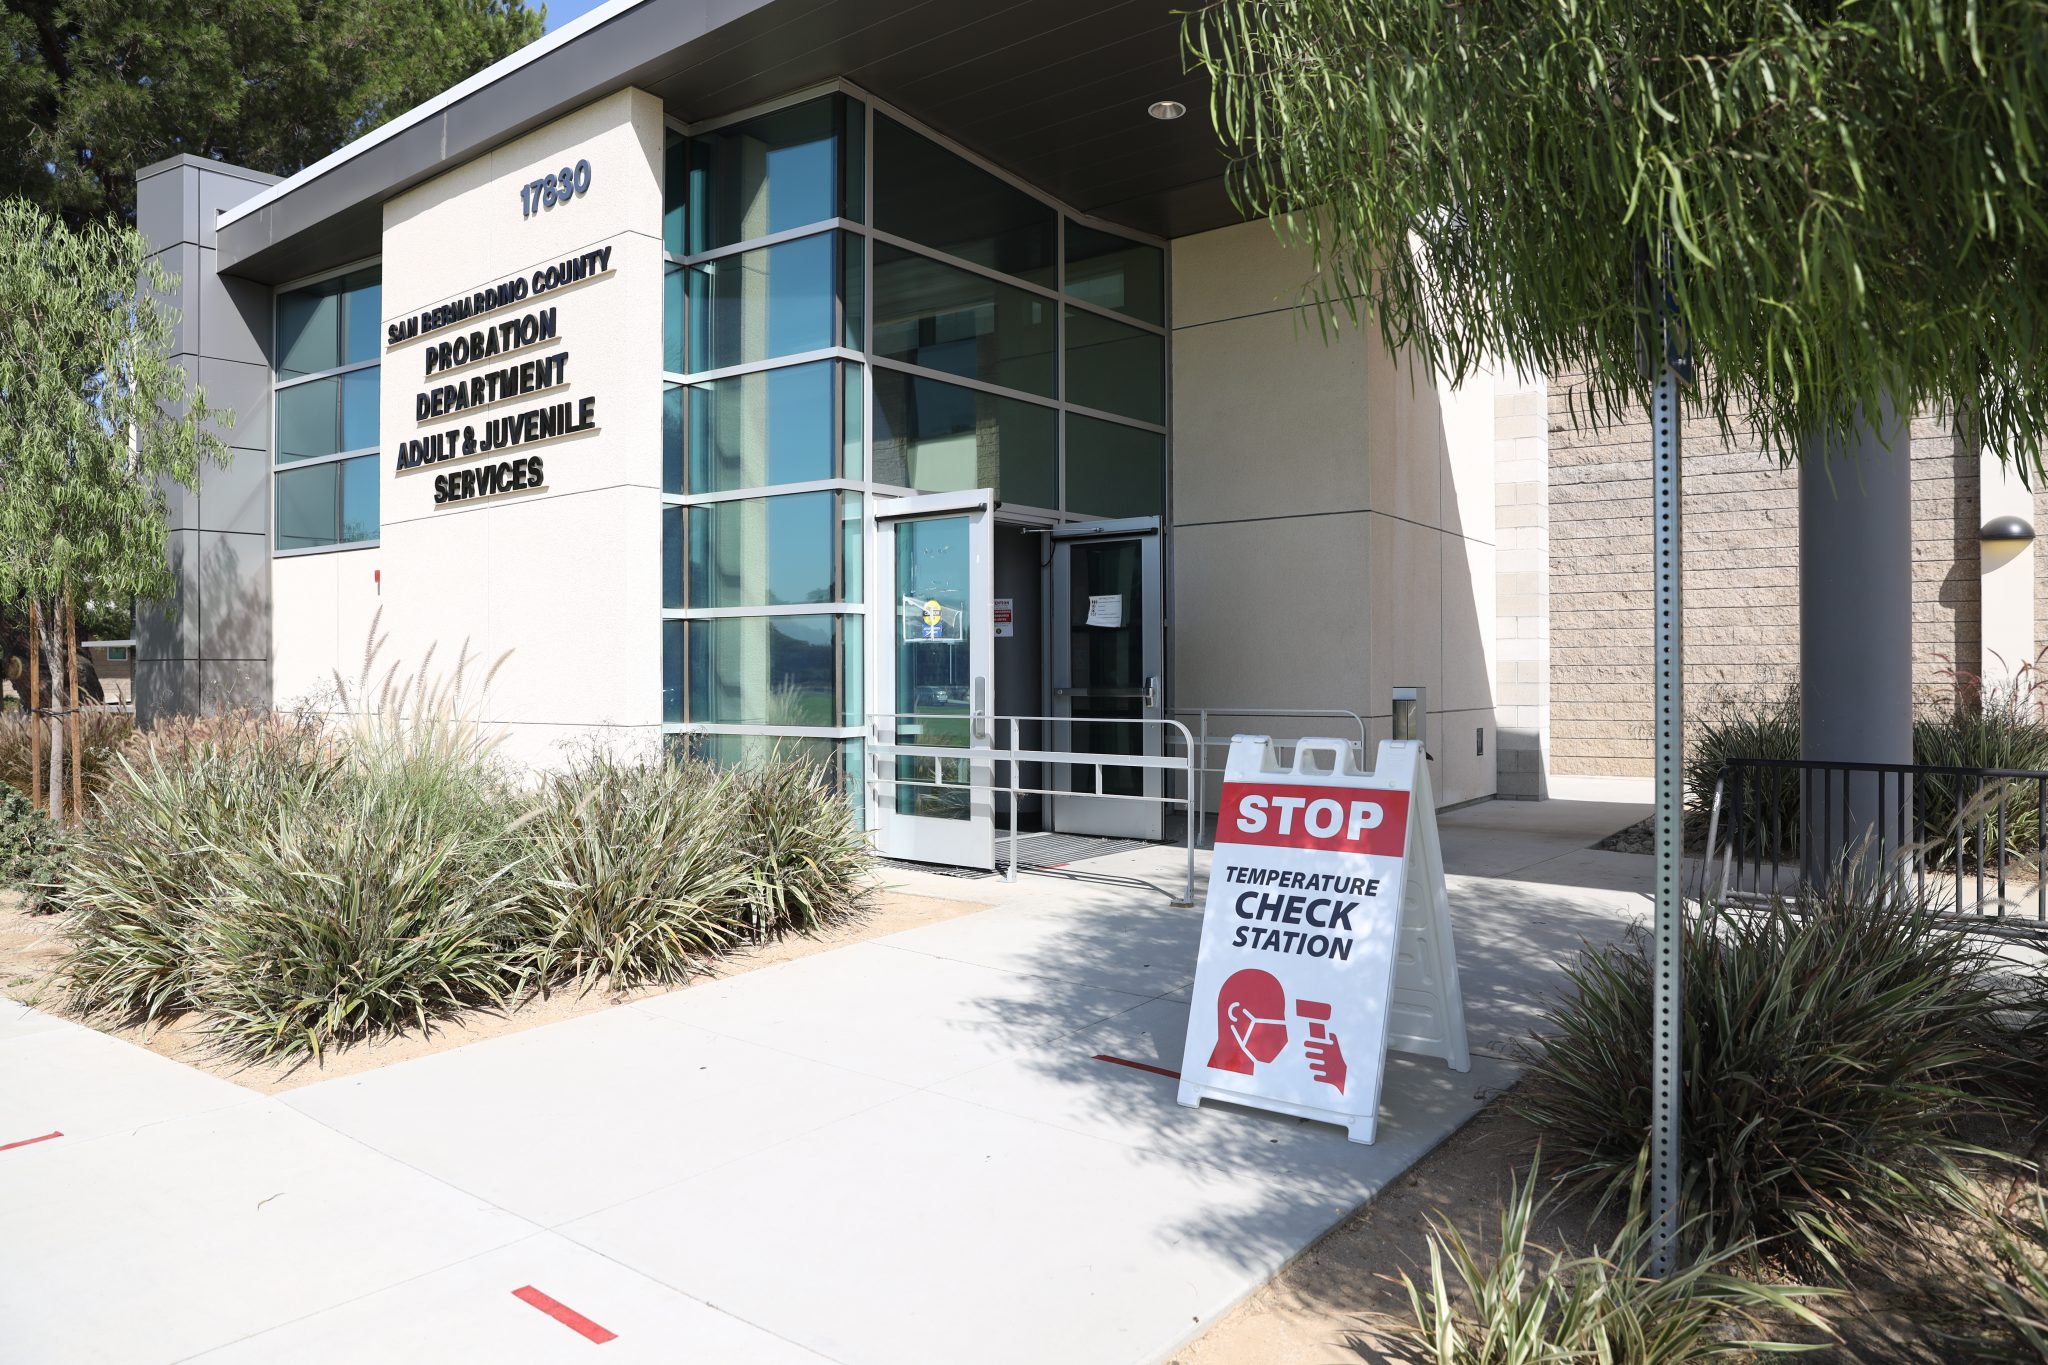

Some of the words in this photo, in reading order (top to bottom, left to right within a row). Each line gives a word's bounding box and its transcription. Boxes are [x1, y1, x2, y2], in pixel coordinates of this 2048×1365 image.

[520, 159, 592, 217] 17830
[388, 316, 419, 345] SAN
[421, 277, 529, 334] BERNARDINO
[531, 246, 612, 295] COUNTY
[425, 307, 557, 376] PROBATION
[416, 352, 569, 422] DEPARTMENT
[396, 429, 460, 471] ADULT
[462, 425, 478, 456] &
[479, 396, 596, 452] JUVENILE
[434, 456, 544, 504] SERVICES
[1236, 794, 1384, 841] STOP
[1226, 866, 1380, 897] TEMPERATURE
[1235, 891, 1360, 931] CHECK
[1232, 926, 1354, 961] STATION
